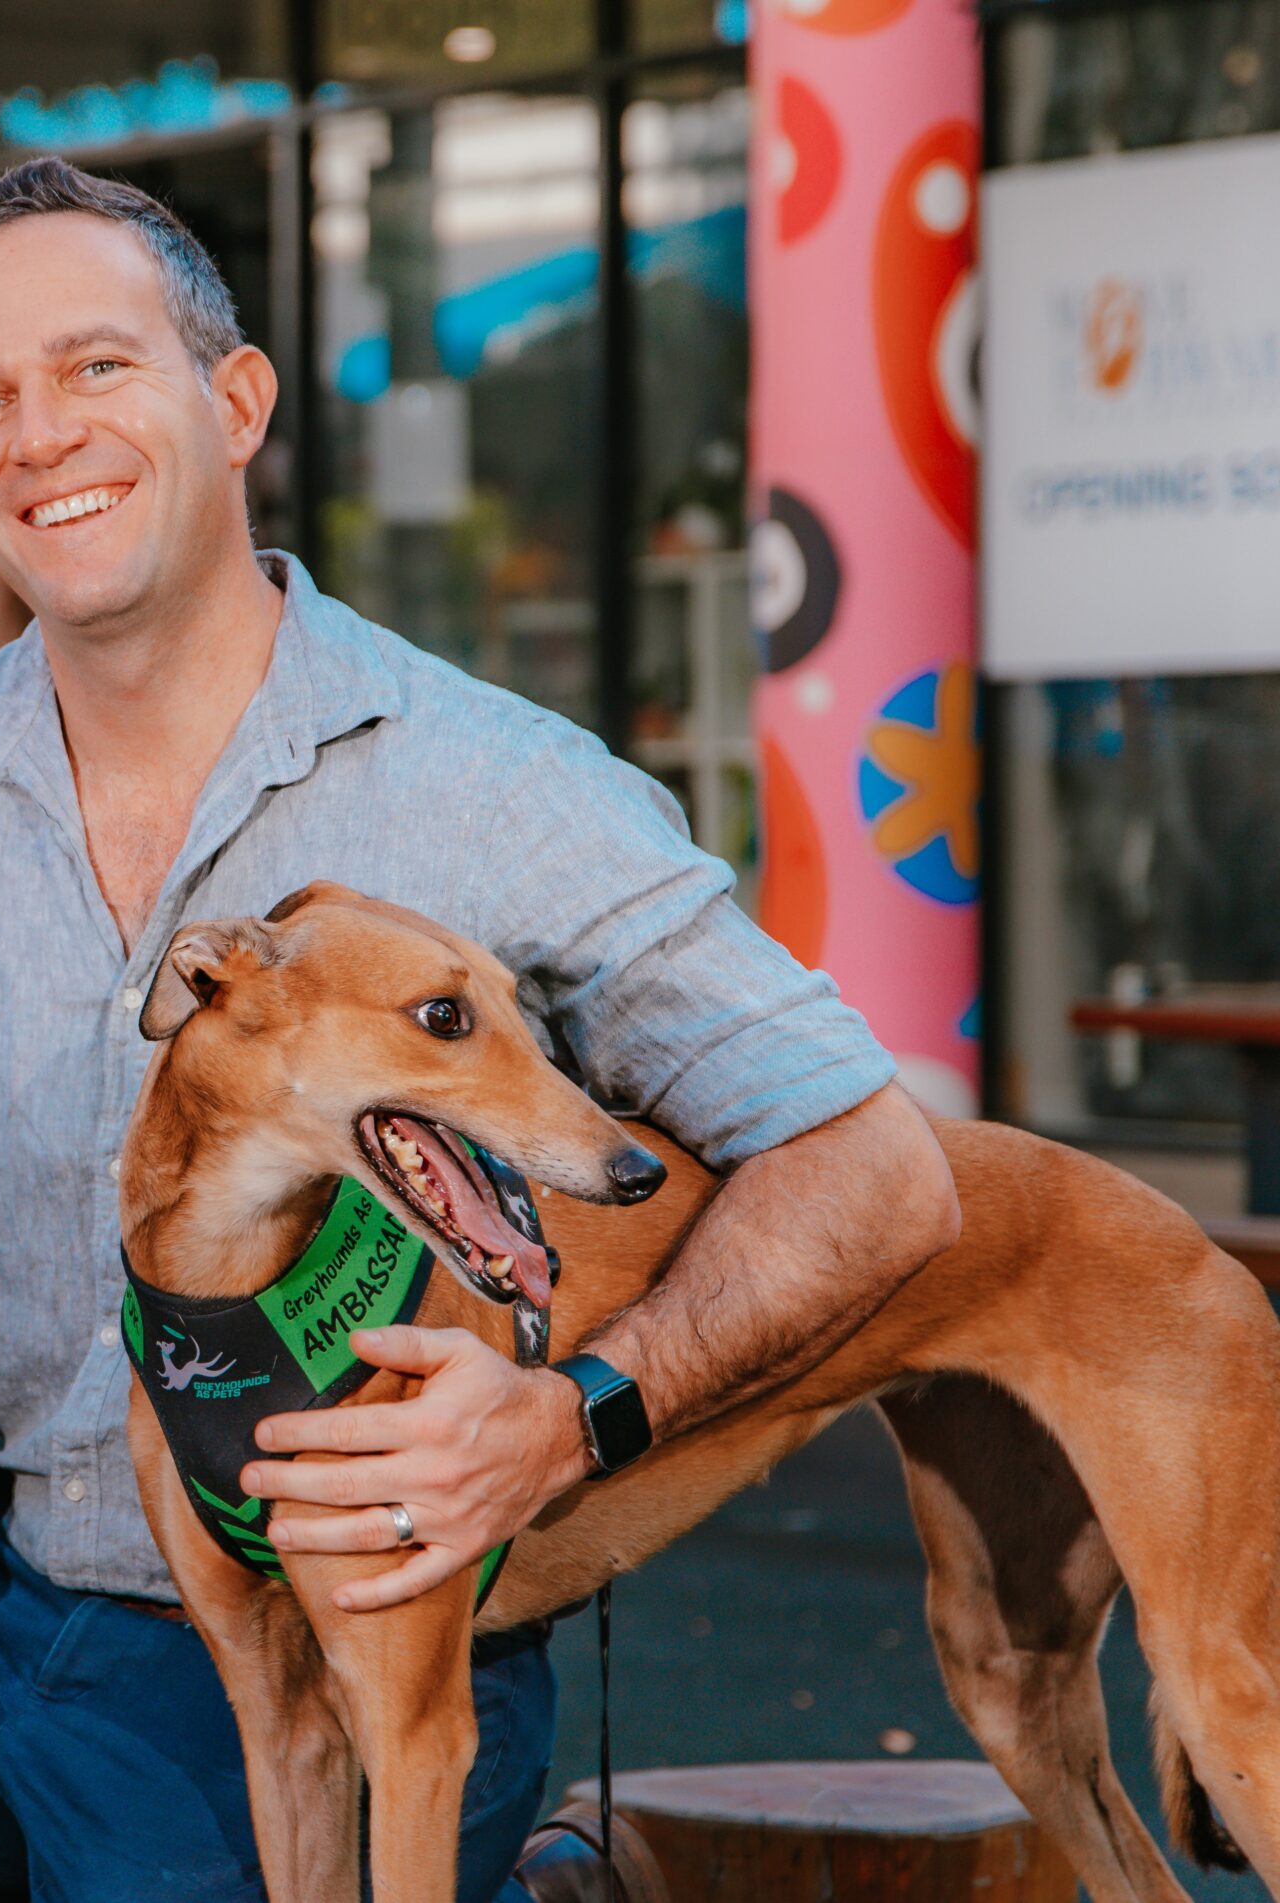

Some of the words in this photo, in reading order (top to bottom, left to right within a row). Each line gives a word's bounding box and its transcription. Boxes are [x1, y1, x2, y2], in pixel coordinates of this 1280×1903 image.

[283, 1224, 361, 1320] Greyhounds
[353, 1196, 373, 1225] As
[193, 1374, 271, 1391] GREYHOUNDS
[196, 1389, 211, 1399] AS
[213, 1388, 241, 1399] PETS
